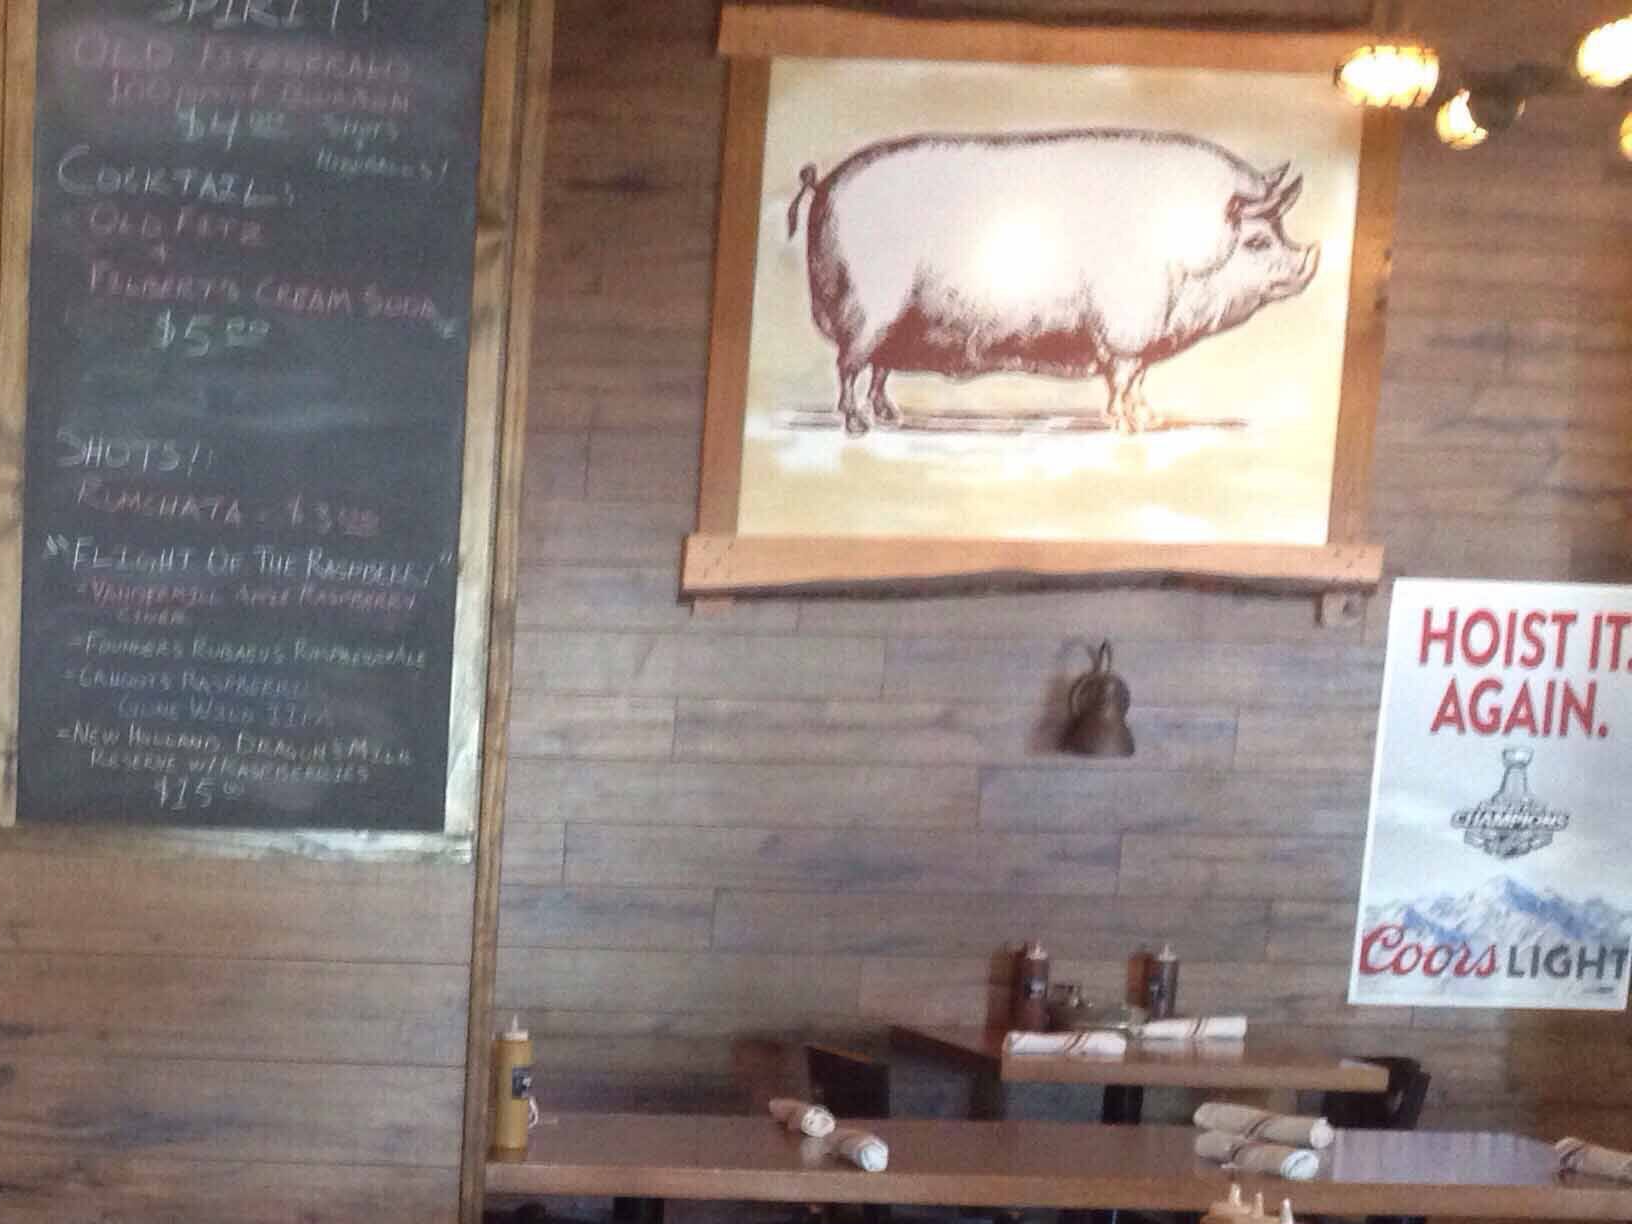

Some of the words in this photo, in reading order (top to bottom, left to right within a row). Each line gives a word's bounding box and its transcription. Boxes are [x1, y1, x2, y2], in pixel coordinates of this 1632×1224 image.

[1418, 606, 1577, 671] HOIST
[71, 719, 120, 746] NEW
[1429, 675, 1610, 739] AGAIN.
[1358, 921, 1498, 978] Coors
[1506, 942, 1629, 981] LIGHT
